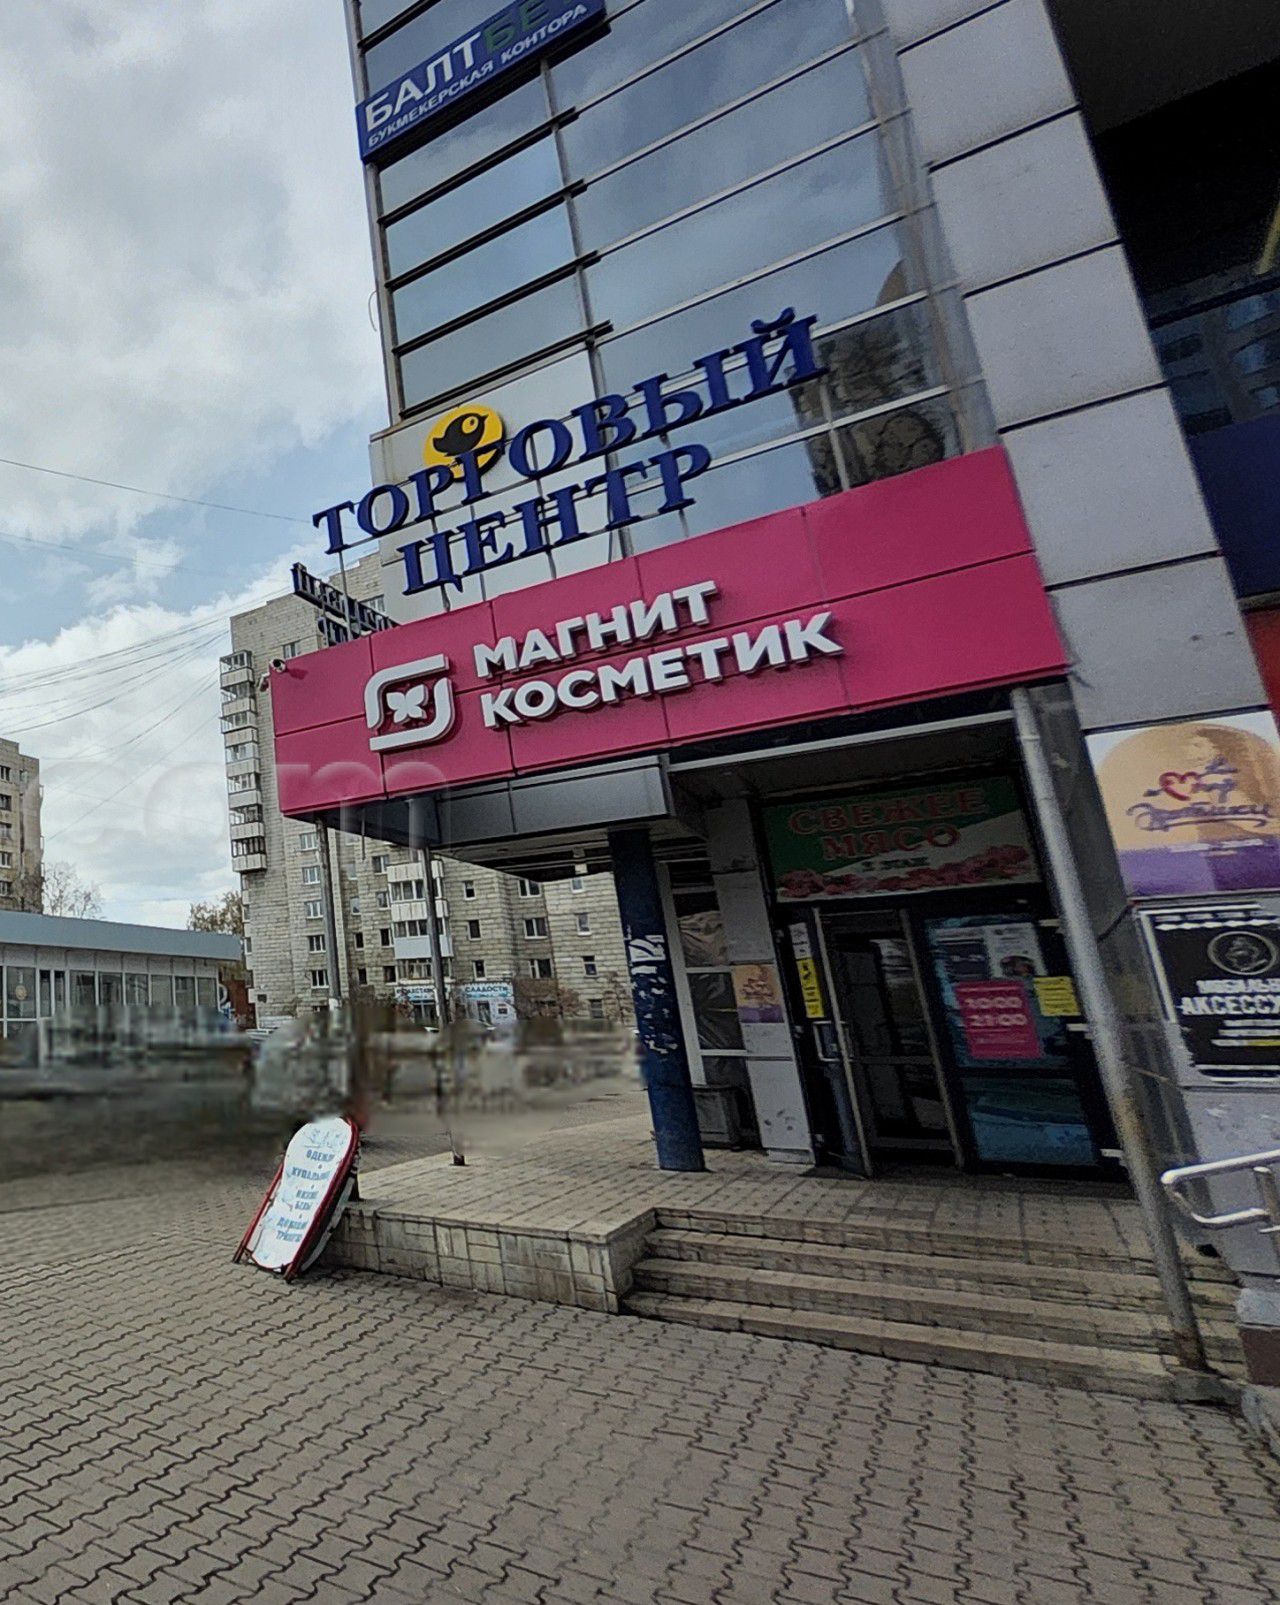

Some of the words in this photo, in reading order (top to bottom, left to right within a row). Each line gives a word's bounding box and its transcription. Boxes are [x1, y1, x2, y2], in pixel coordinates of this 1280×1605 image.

[369, 60, 493, 147] БУКМЕКЕРСКАЯ
[501, 5, 587, 63] КОНТОРА
[312, 307, 825, 555] ТОРГОВЫЙ
[397, 445, 711, 597] ЦЕНТР
[473, 581, 718, 679] МАГНИТ
[480, 612, 843, 729] КОСМЕТИК
[789, 788, 989, 835] СВЕЖЕЕ
[822, 823, 961, 861] МЯСО
